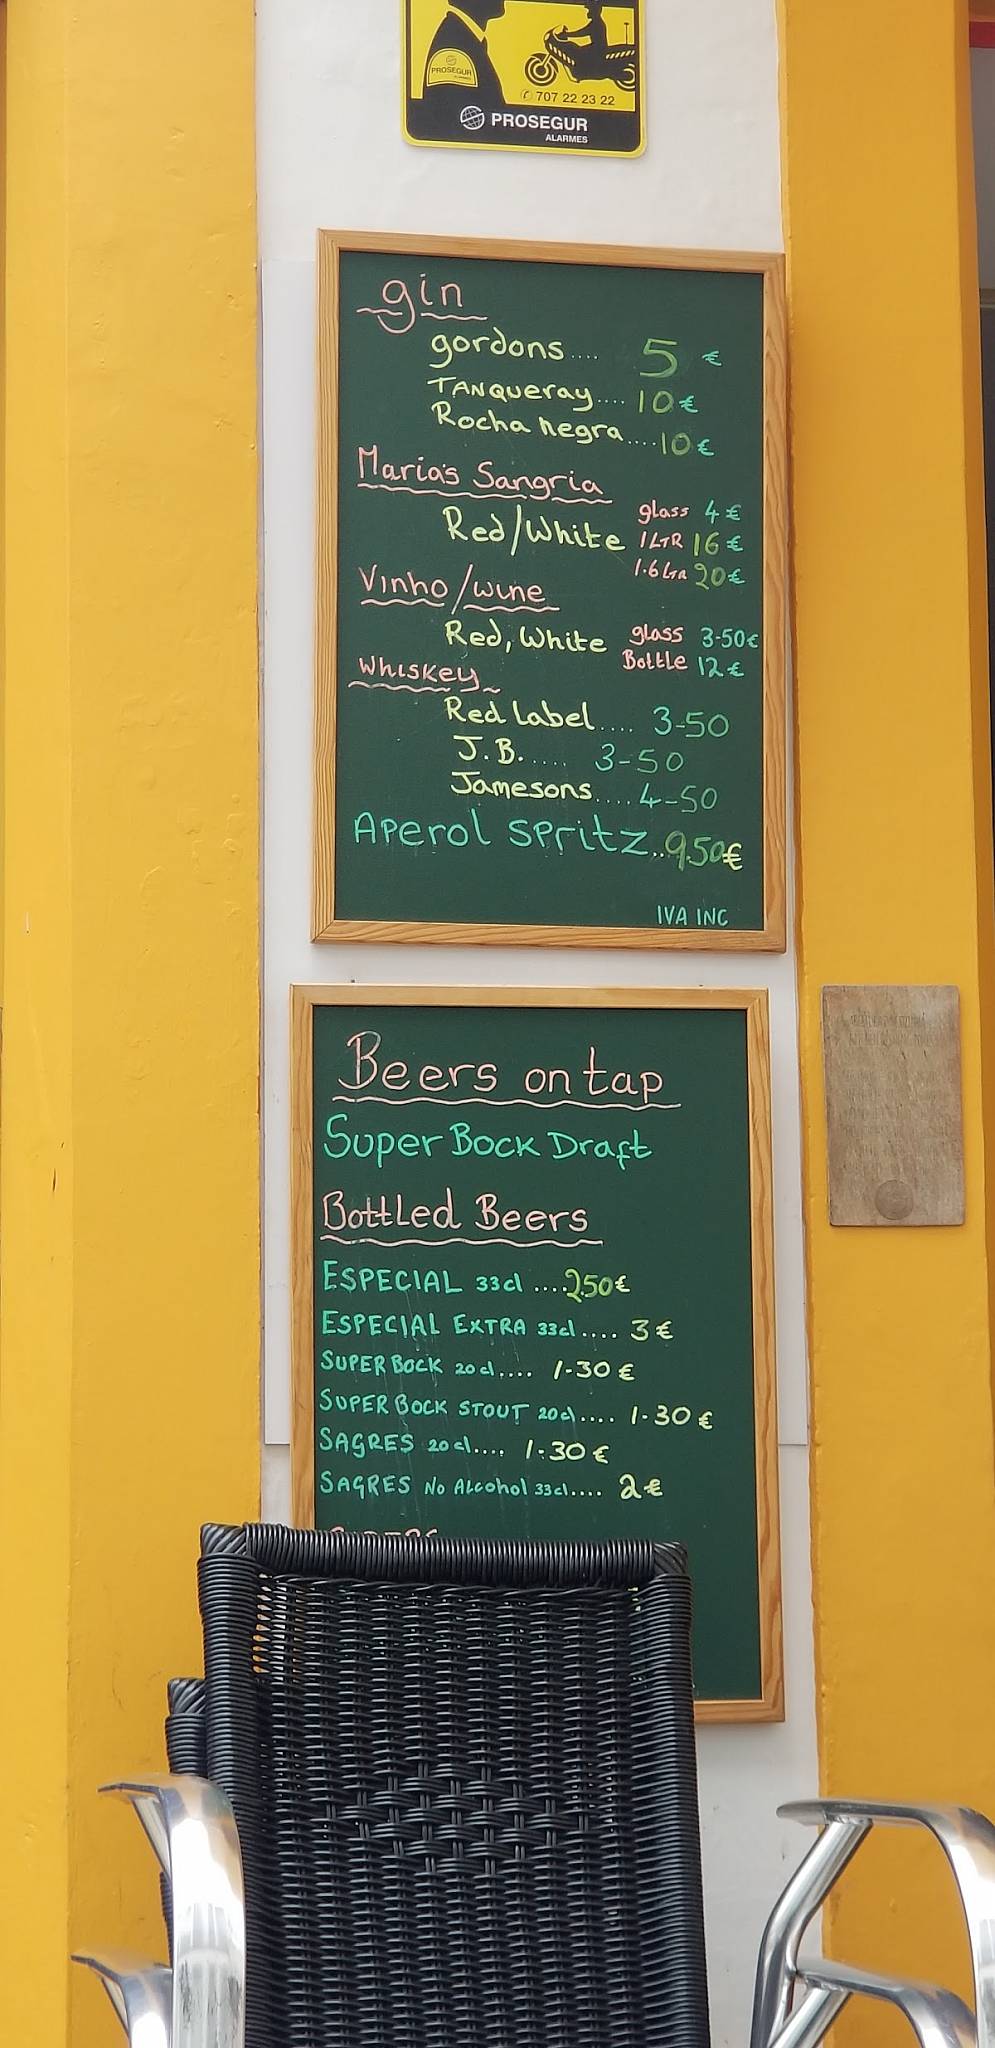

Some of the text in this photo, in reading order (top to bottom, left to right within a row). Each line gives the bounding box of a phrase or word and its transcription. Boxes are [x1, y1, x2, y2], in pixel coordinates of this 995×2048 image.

[431, 66, 472, 76] PROSEGUR
[536, 91, 615, 106] 707 22 23 22
[491, 112, 588, 132] PROSEGUR
[545, 133, 588, 144] ALARMES
[377, 273, 463, 334] gin
[639, 338, 678, 377] 5
[431, 401, 531, 433] Rocha
[473, 461, 603, 500] Sangria
[637, 500, 690, 525] glass
[519, 625, 608, 653] White
[629, 624, 684, 646] glass
[622, 649, 688, 670] Bottle
[444, 696, 507, 724] Red
[450, 771, 593, 801] Jamesons
[657, 905, 728, 926] IVA INC
[338, 1031, 664, 1104] Beers on tap
[324, 1113, 444, 1168] Super
[547, 1129, 653, 1170] Draft
[322, 1188, 589, 1232] Bottled Beers
[323, 1260, 463, 1294] ESPECIAL
[322, 1310, 440, 1339] ESPECIAL
[453, 1314, 526, 1336] EXTRA
[320, 1349, 386, 1376] SUPER
[391, 1354, 444, 1374] BOCK
[319, 1388, 389, 1415] SUPER
[395, 1393, 448, 1415] BOCK
[458, 1400, 530, 1425] STOUT
[319, 1426, 415, 1459] SAGRES
[319, 1470, 411, 1499] SAGRES
[424, 1476, 445, 1495] No
